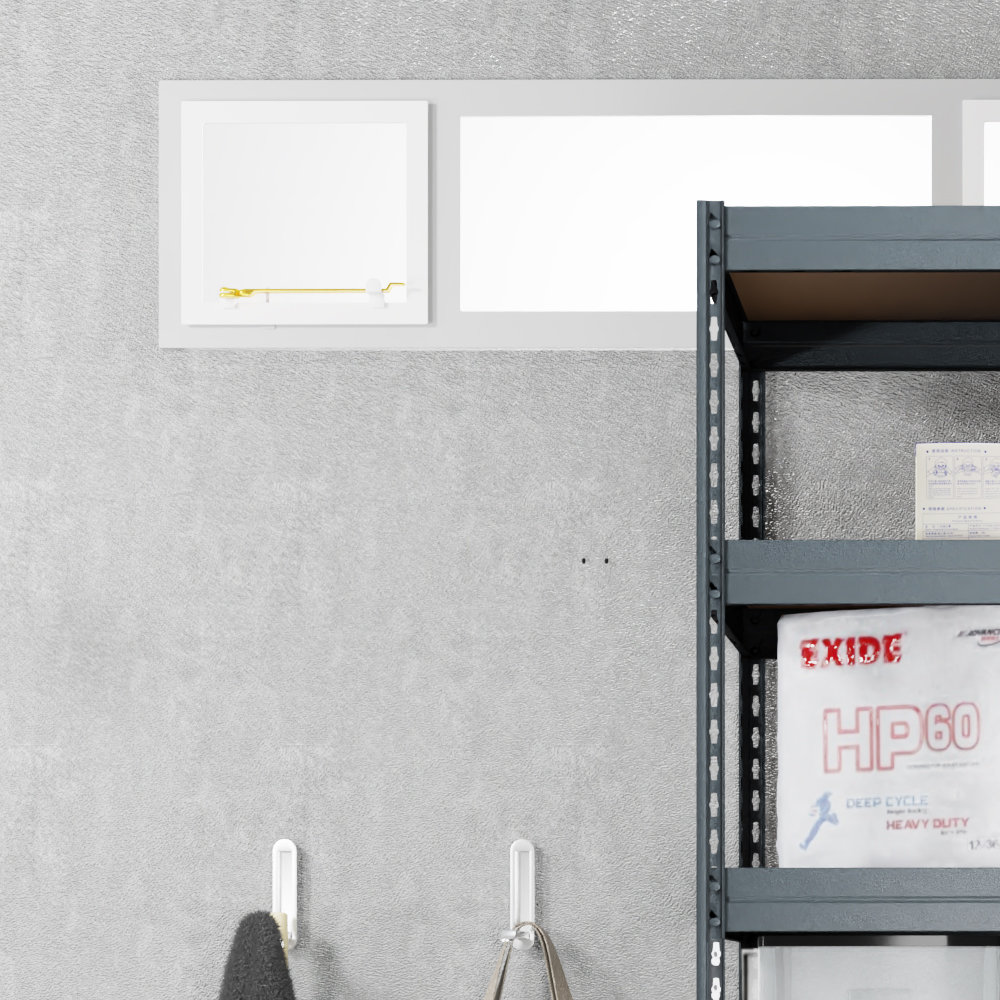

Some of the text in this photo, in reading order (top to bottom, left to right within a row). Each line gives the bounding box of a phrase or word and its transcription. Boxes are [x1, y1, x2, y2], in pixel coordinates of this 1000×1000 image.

[800, 633, 903, 669] EXIDE
[823, 702, 980, 774] HP60
[846, 795, 928, 809] DEEP CYCLE
[886, 817, 969, 831] HEAVY DUTY
